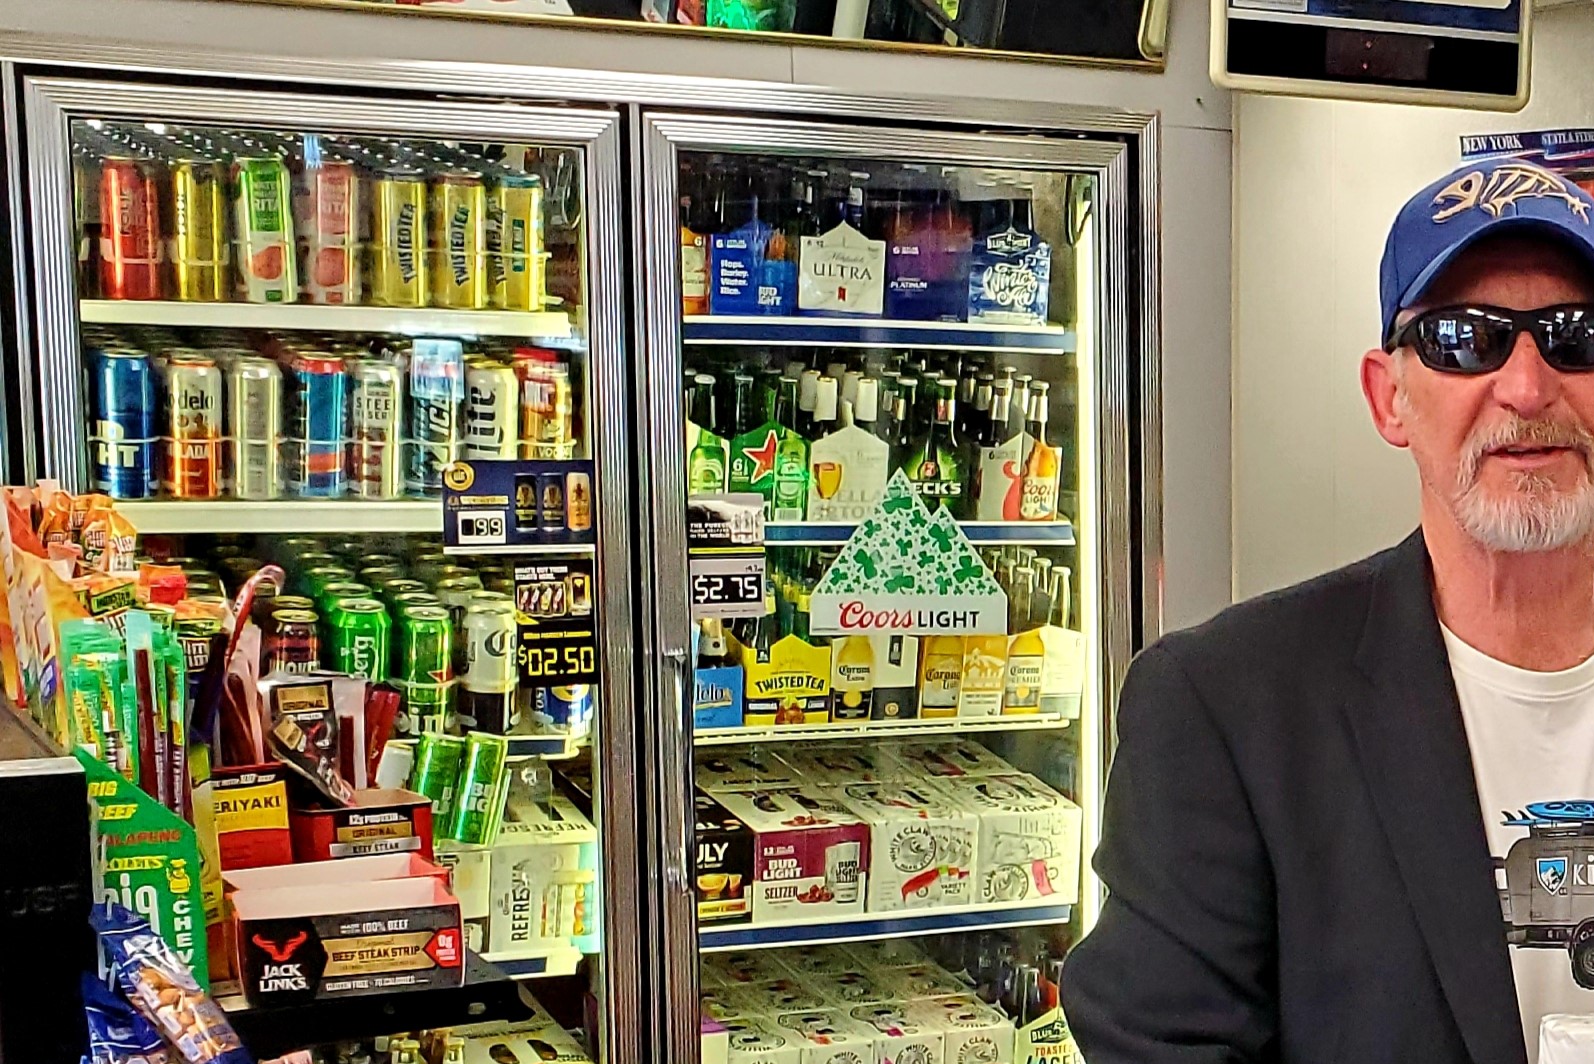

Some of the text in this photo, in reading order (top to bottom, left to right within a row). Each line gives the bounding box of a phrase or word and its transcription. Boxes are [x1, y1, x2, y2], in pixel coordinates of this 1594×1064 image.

[1462, 136, 1485, 153] NEW
[1488, 133, 1522, 149] YORK
[813, 262, 872, 280] ULTRA
[891, 281, 928, 290] PLATINUM
[912, 481, 962, 496] ECK'S
[694, 574, 758, 603] $2.75
[838, 600, 981, 630] Coors LIGHT
[838, 665, 871, 675] Corona
[925, 668, 961, 682] Corona
[754, 675, 825, 694] TWISTED TEA
[213, 795, 281, 814] ERIYAKI
[768, 858, 797, 870] BUD
[763, 867, 802, 880] LIGHT
[764, 885, 798, 900] SELTZER
[332, 945, 420, 963] BEEF STEAK STRIP
[262, 964, 302, 979] JACK
